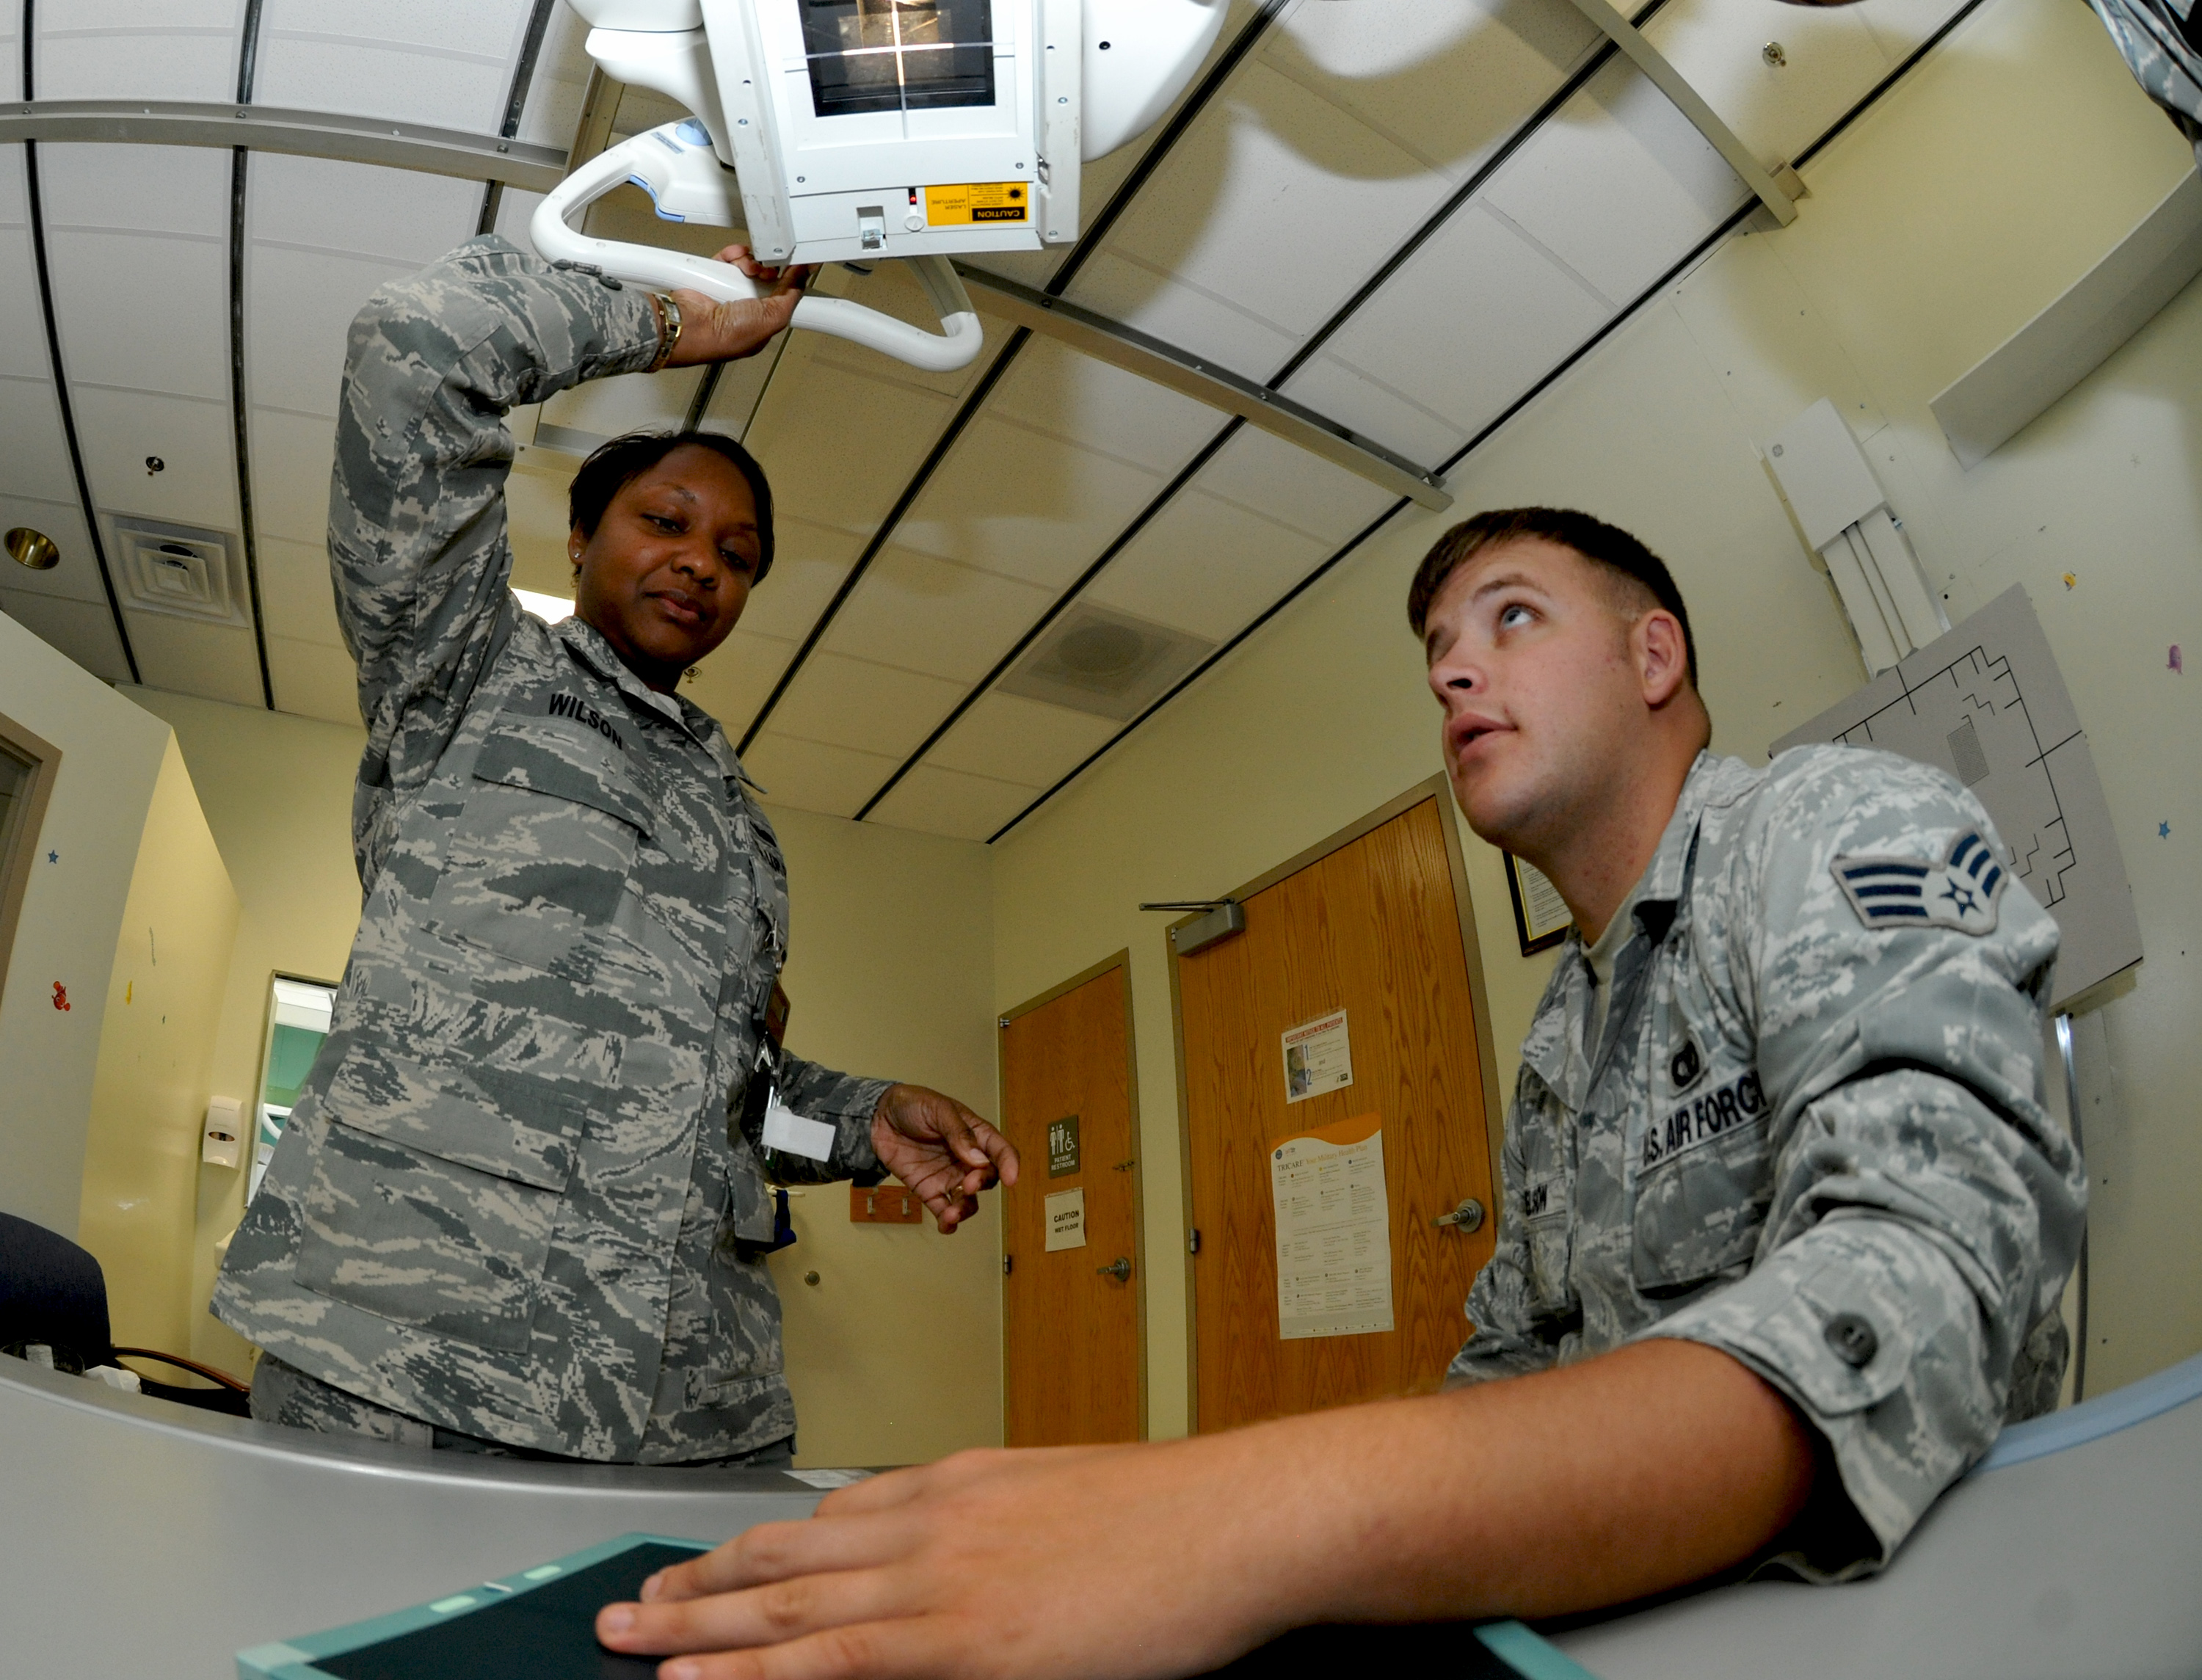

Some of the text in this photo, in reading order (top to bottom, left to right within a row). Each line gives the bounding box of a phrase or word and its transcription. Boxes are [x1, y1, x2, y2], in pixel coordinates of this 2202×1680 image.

[977, 210, 1020, 218] CAUTION
[548, 694, 622, 749] WILSON
[1307, 1069, 1312, 1086] 2
[1666, 1109, 1691, 1154] AIR
[1054, 1154, 1072, 1163] PATIENT
[1051, 1160, 1075, 1171] RESTROOM
[1277, 1160, 1303, 1171] TRICARE
[1053, 1210, 1080, 1223] CAUTION
[1055, 1222, 1079, 1234] WET FLOOR
